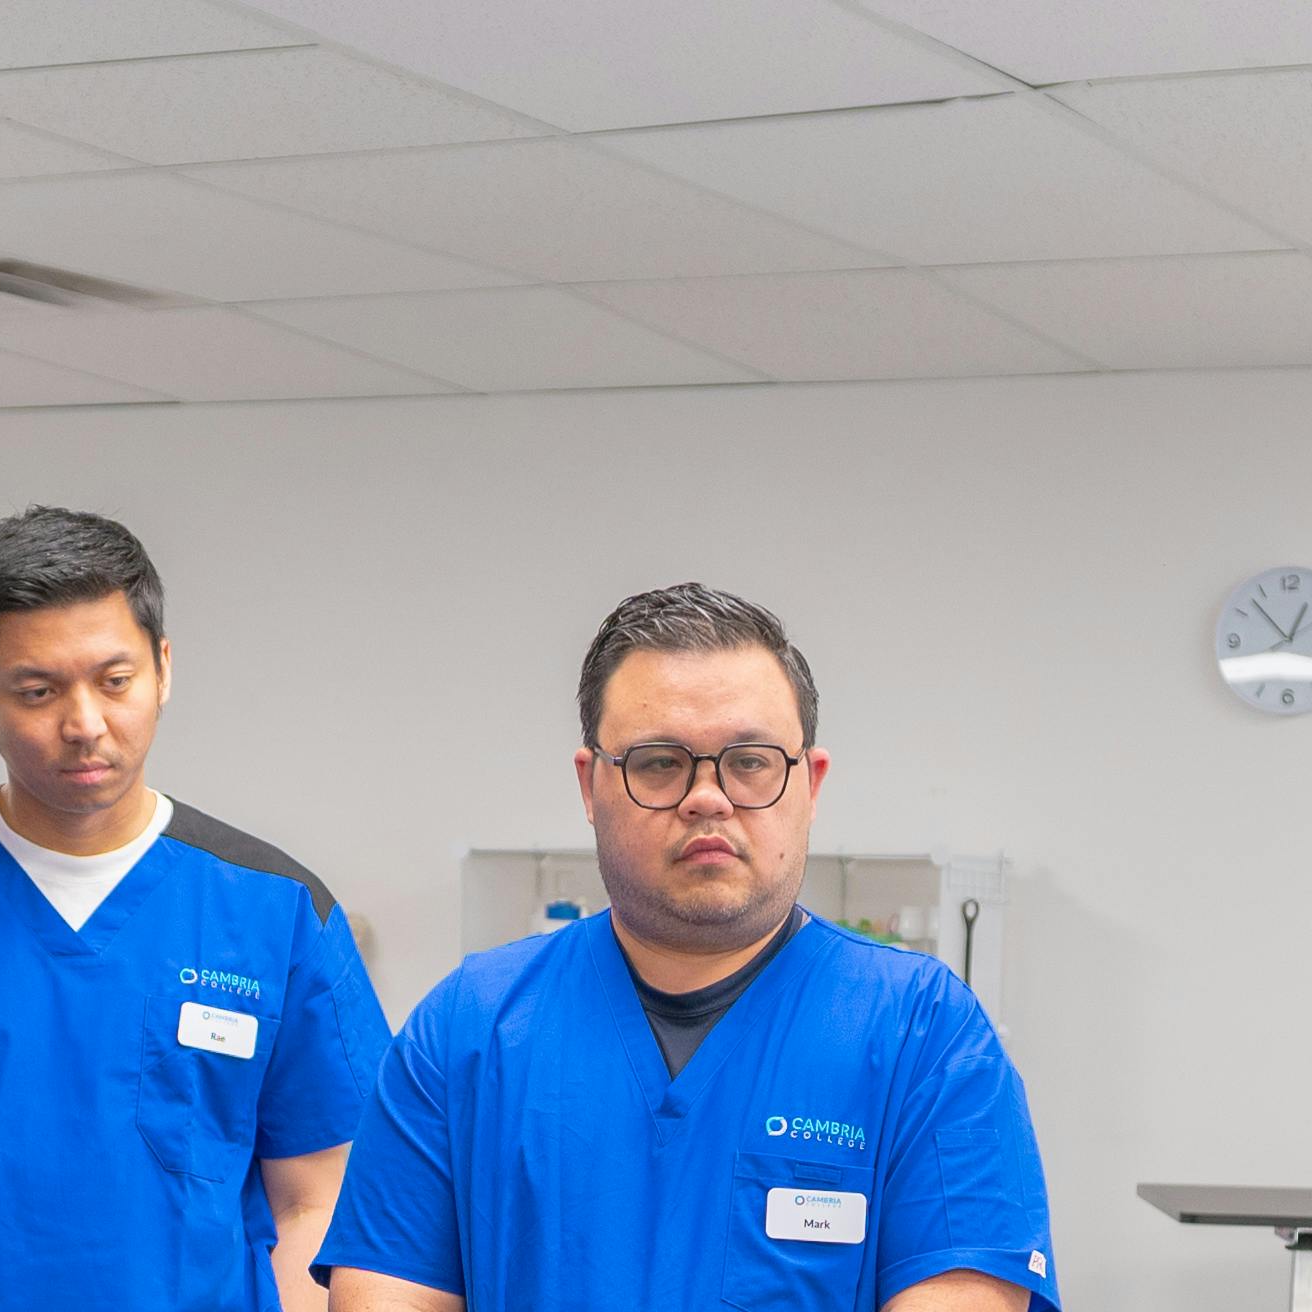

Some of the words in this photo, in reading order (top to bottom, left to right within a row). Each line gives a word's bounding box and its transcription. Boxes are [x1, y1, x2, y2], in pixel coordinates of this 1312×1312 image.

[1280, 574, 1301, 591] 12
[1226, 632, 1241, 649] 9
[1281, 688, 1295, 705] 6
[201, 969, 260, 992] CAMBRIA
[200, 980, 260, 1000] COLLEGE
[792, 1117, 866, 1142] CAMBRIA
[790, 1131, 866, 1149] COLLEGE
[804, 1218, 831, 1230] Mark
